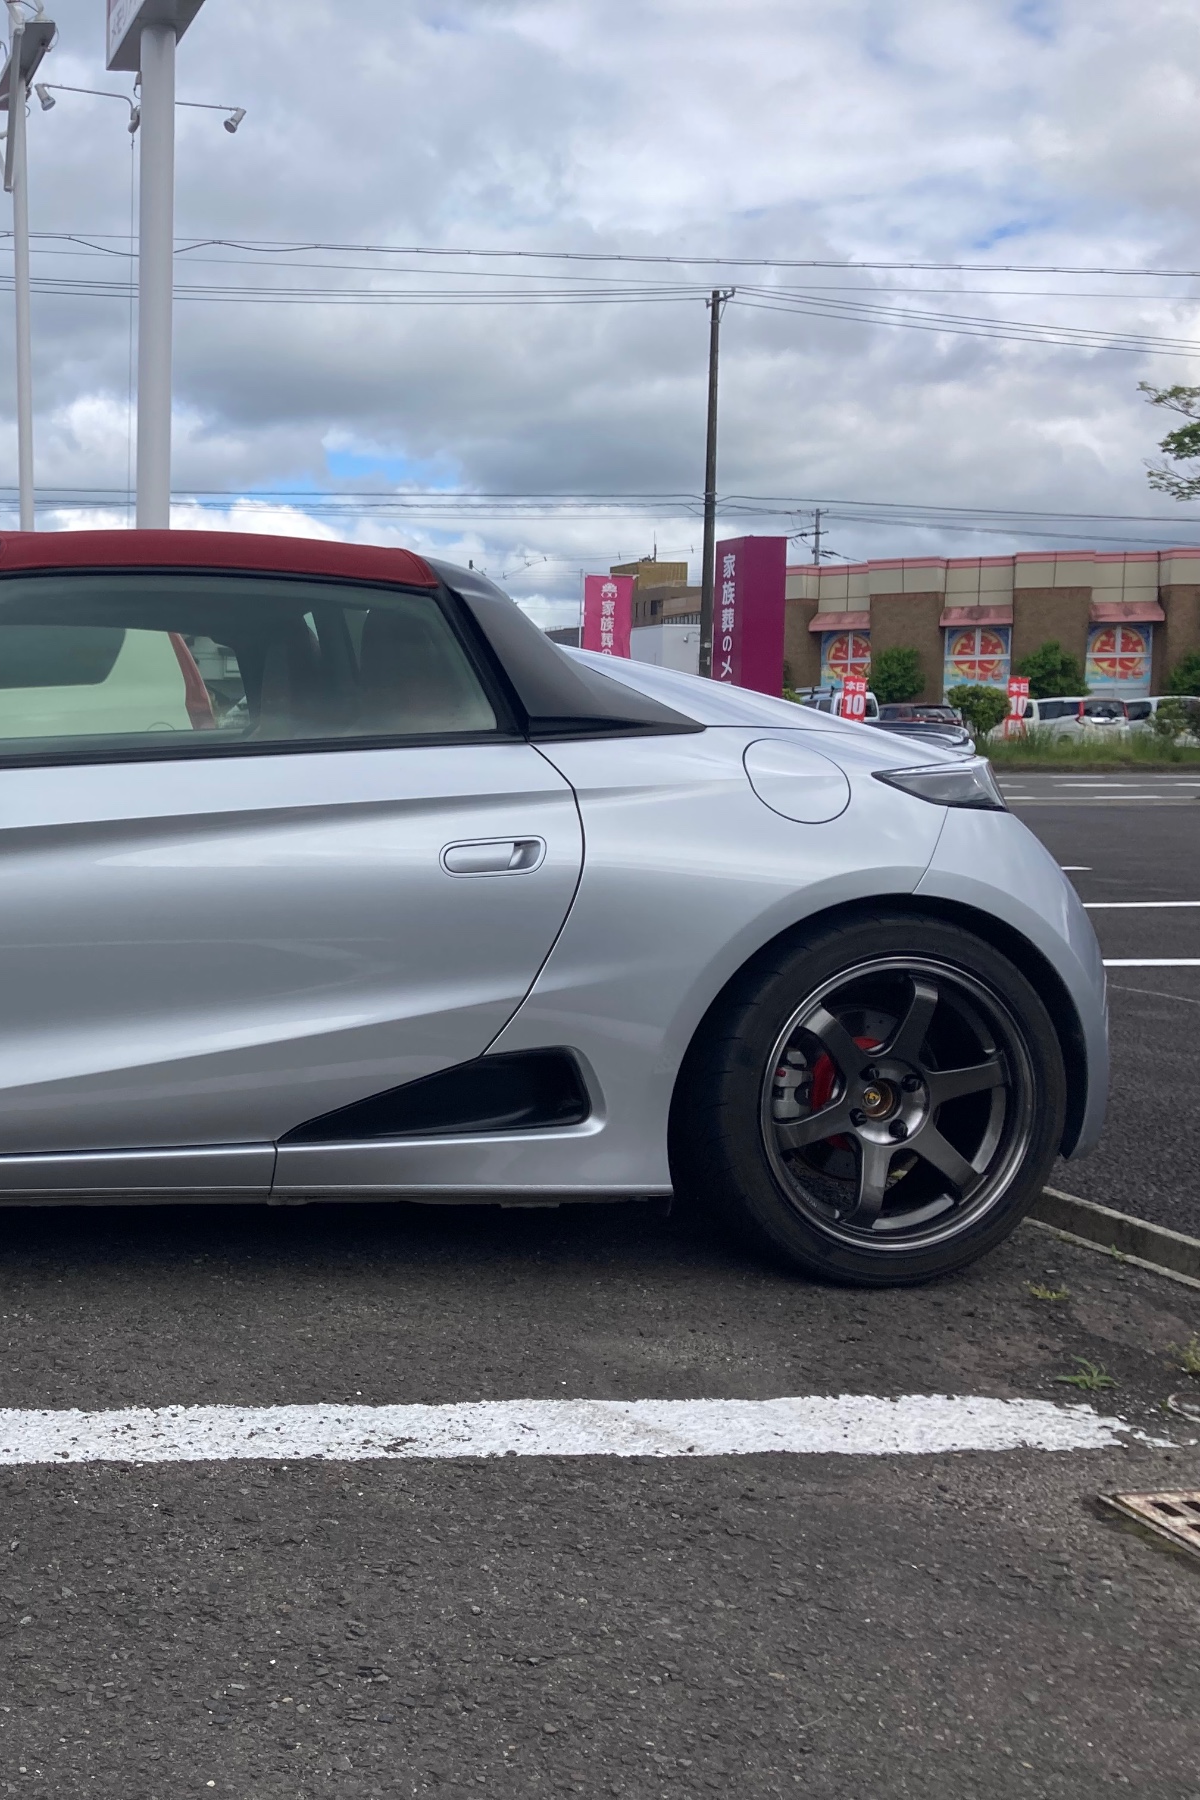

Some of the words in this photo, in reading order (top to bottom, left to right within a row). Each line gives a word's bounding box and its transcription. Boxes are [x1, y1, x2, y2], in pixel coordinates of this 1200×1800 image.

[721, 553, 736, 685] 家族葬のメ
[845, 681, 866, 692] 本日
[1009, 682, 1029, 693] 本日
